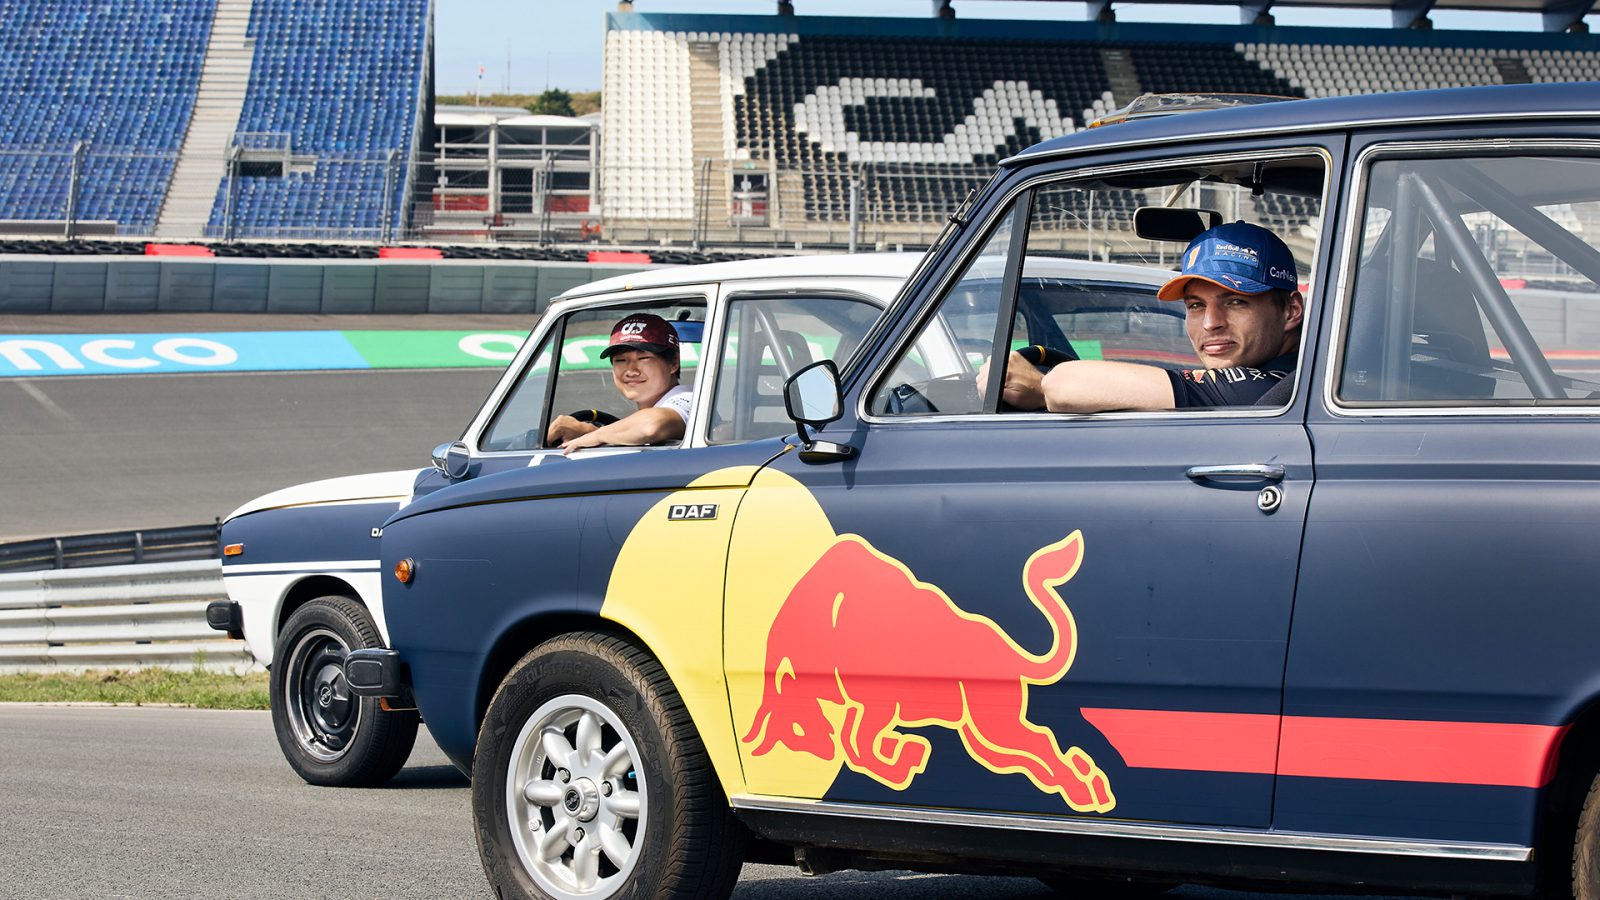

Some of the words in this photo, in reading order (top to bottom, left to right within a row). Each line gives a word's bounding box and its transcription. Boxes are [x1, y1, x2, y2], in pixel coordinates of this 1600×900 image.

[1187, 245, 1201, 270] 1
[1215, 251, 1257, 262] RACING
[671, 505, 714, 518] DAF
